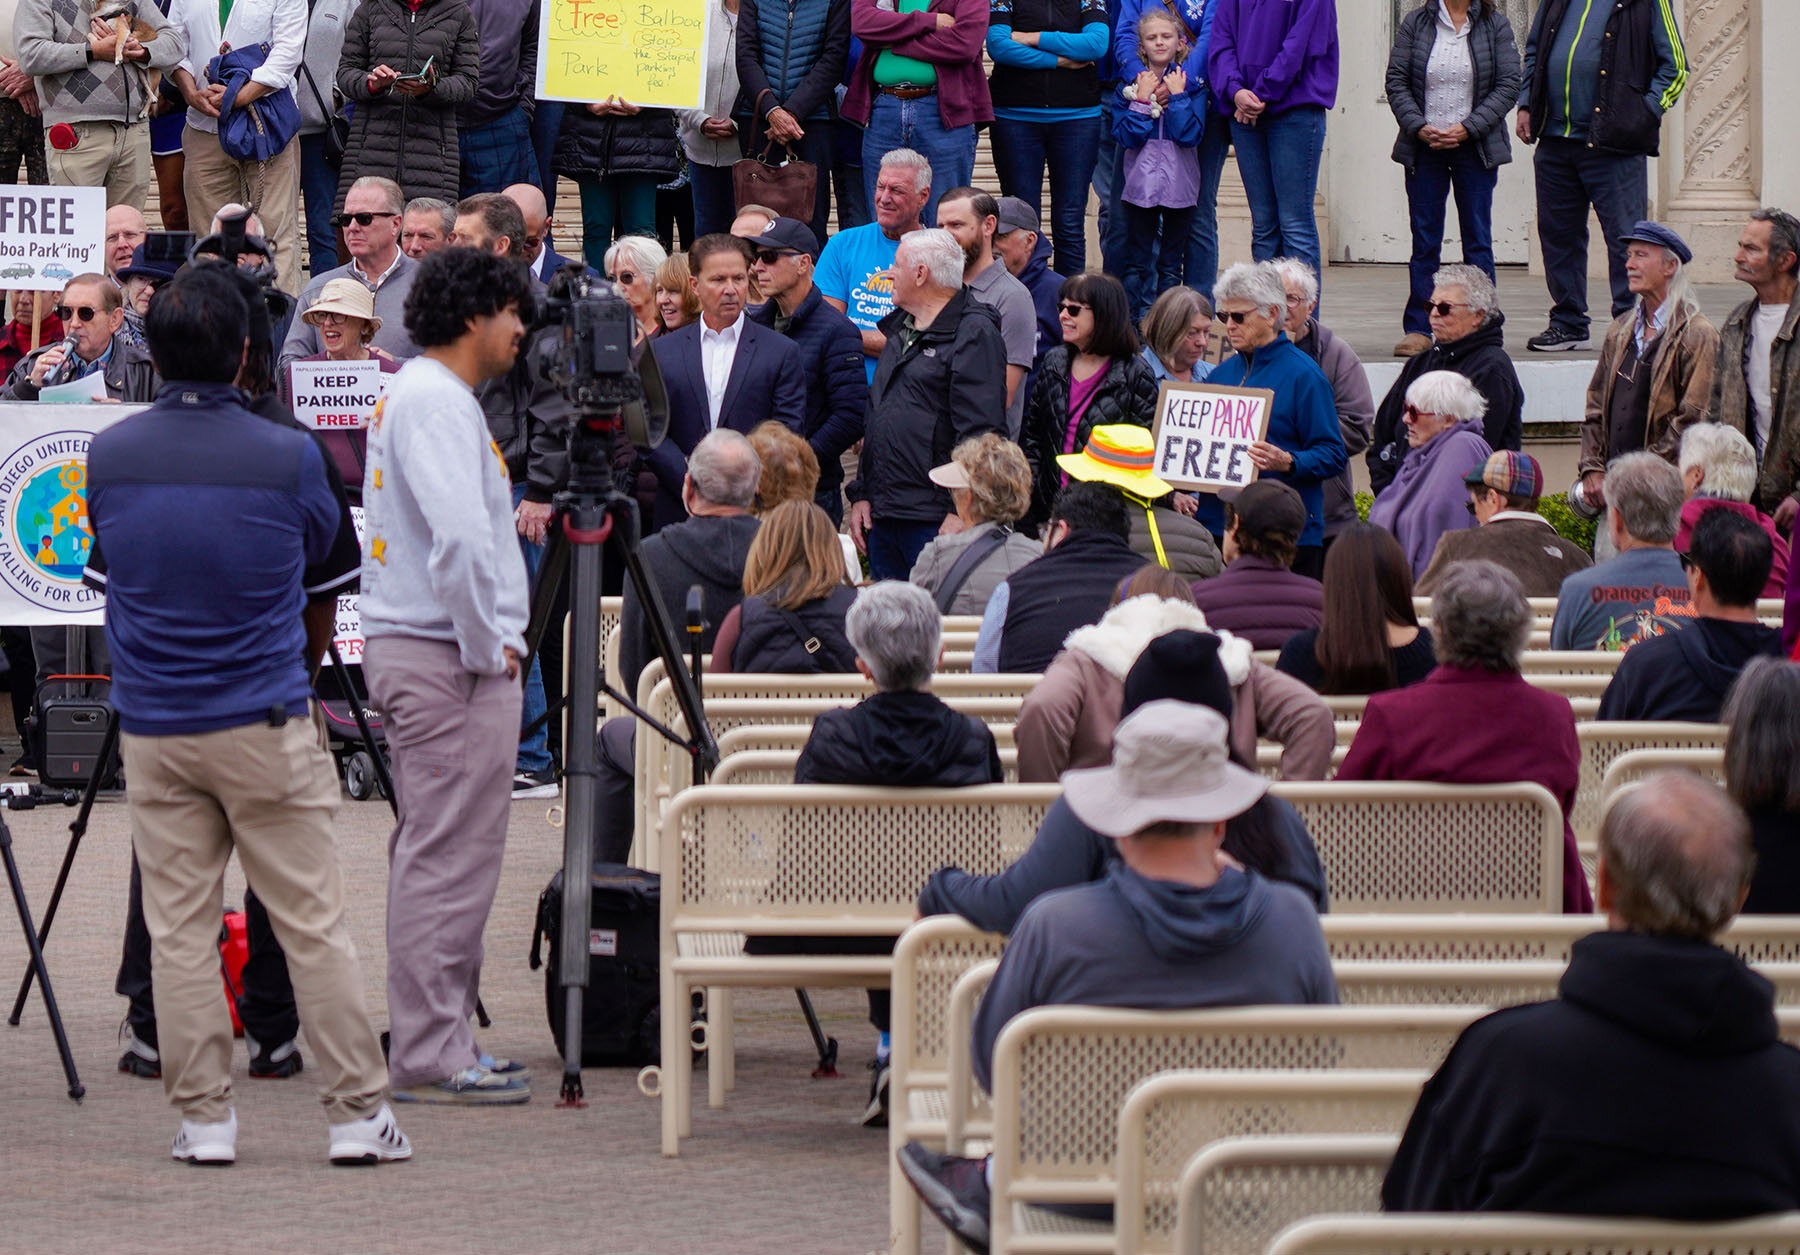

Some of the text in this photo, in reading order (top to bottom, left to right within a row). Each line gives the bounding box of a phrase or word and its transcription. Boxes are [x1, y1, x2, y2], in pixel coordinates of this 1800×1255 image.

[566, 0, 702, 30] Free Balboa
[641, 33, 676, 48] Stop
[633, 48, 651, 59] the
[561, 51, 608, 76] Park
[0, 196, 74, 235] FREE
[851, 288, 894, 305] Commu
[313, 375, 358, 388] KEEP
[297, 394, 376, 407] PARKING
[316, 414, 359, 426] FREE
[1166, 398, 1260, 441] KEEP PARK
[0, 455, 34, 494] DIEGO
[36, 439, 91, 460] UNITED
[1161, 435, 1249, 483] FREE
[44, 585, 71, 602] FOR
[77, 588, 98, 602] CIT
[1591, 583, 1692, 604] Orange Coun
